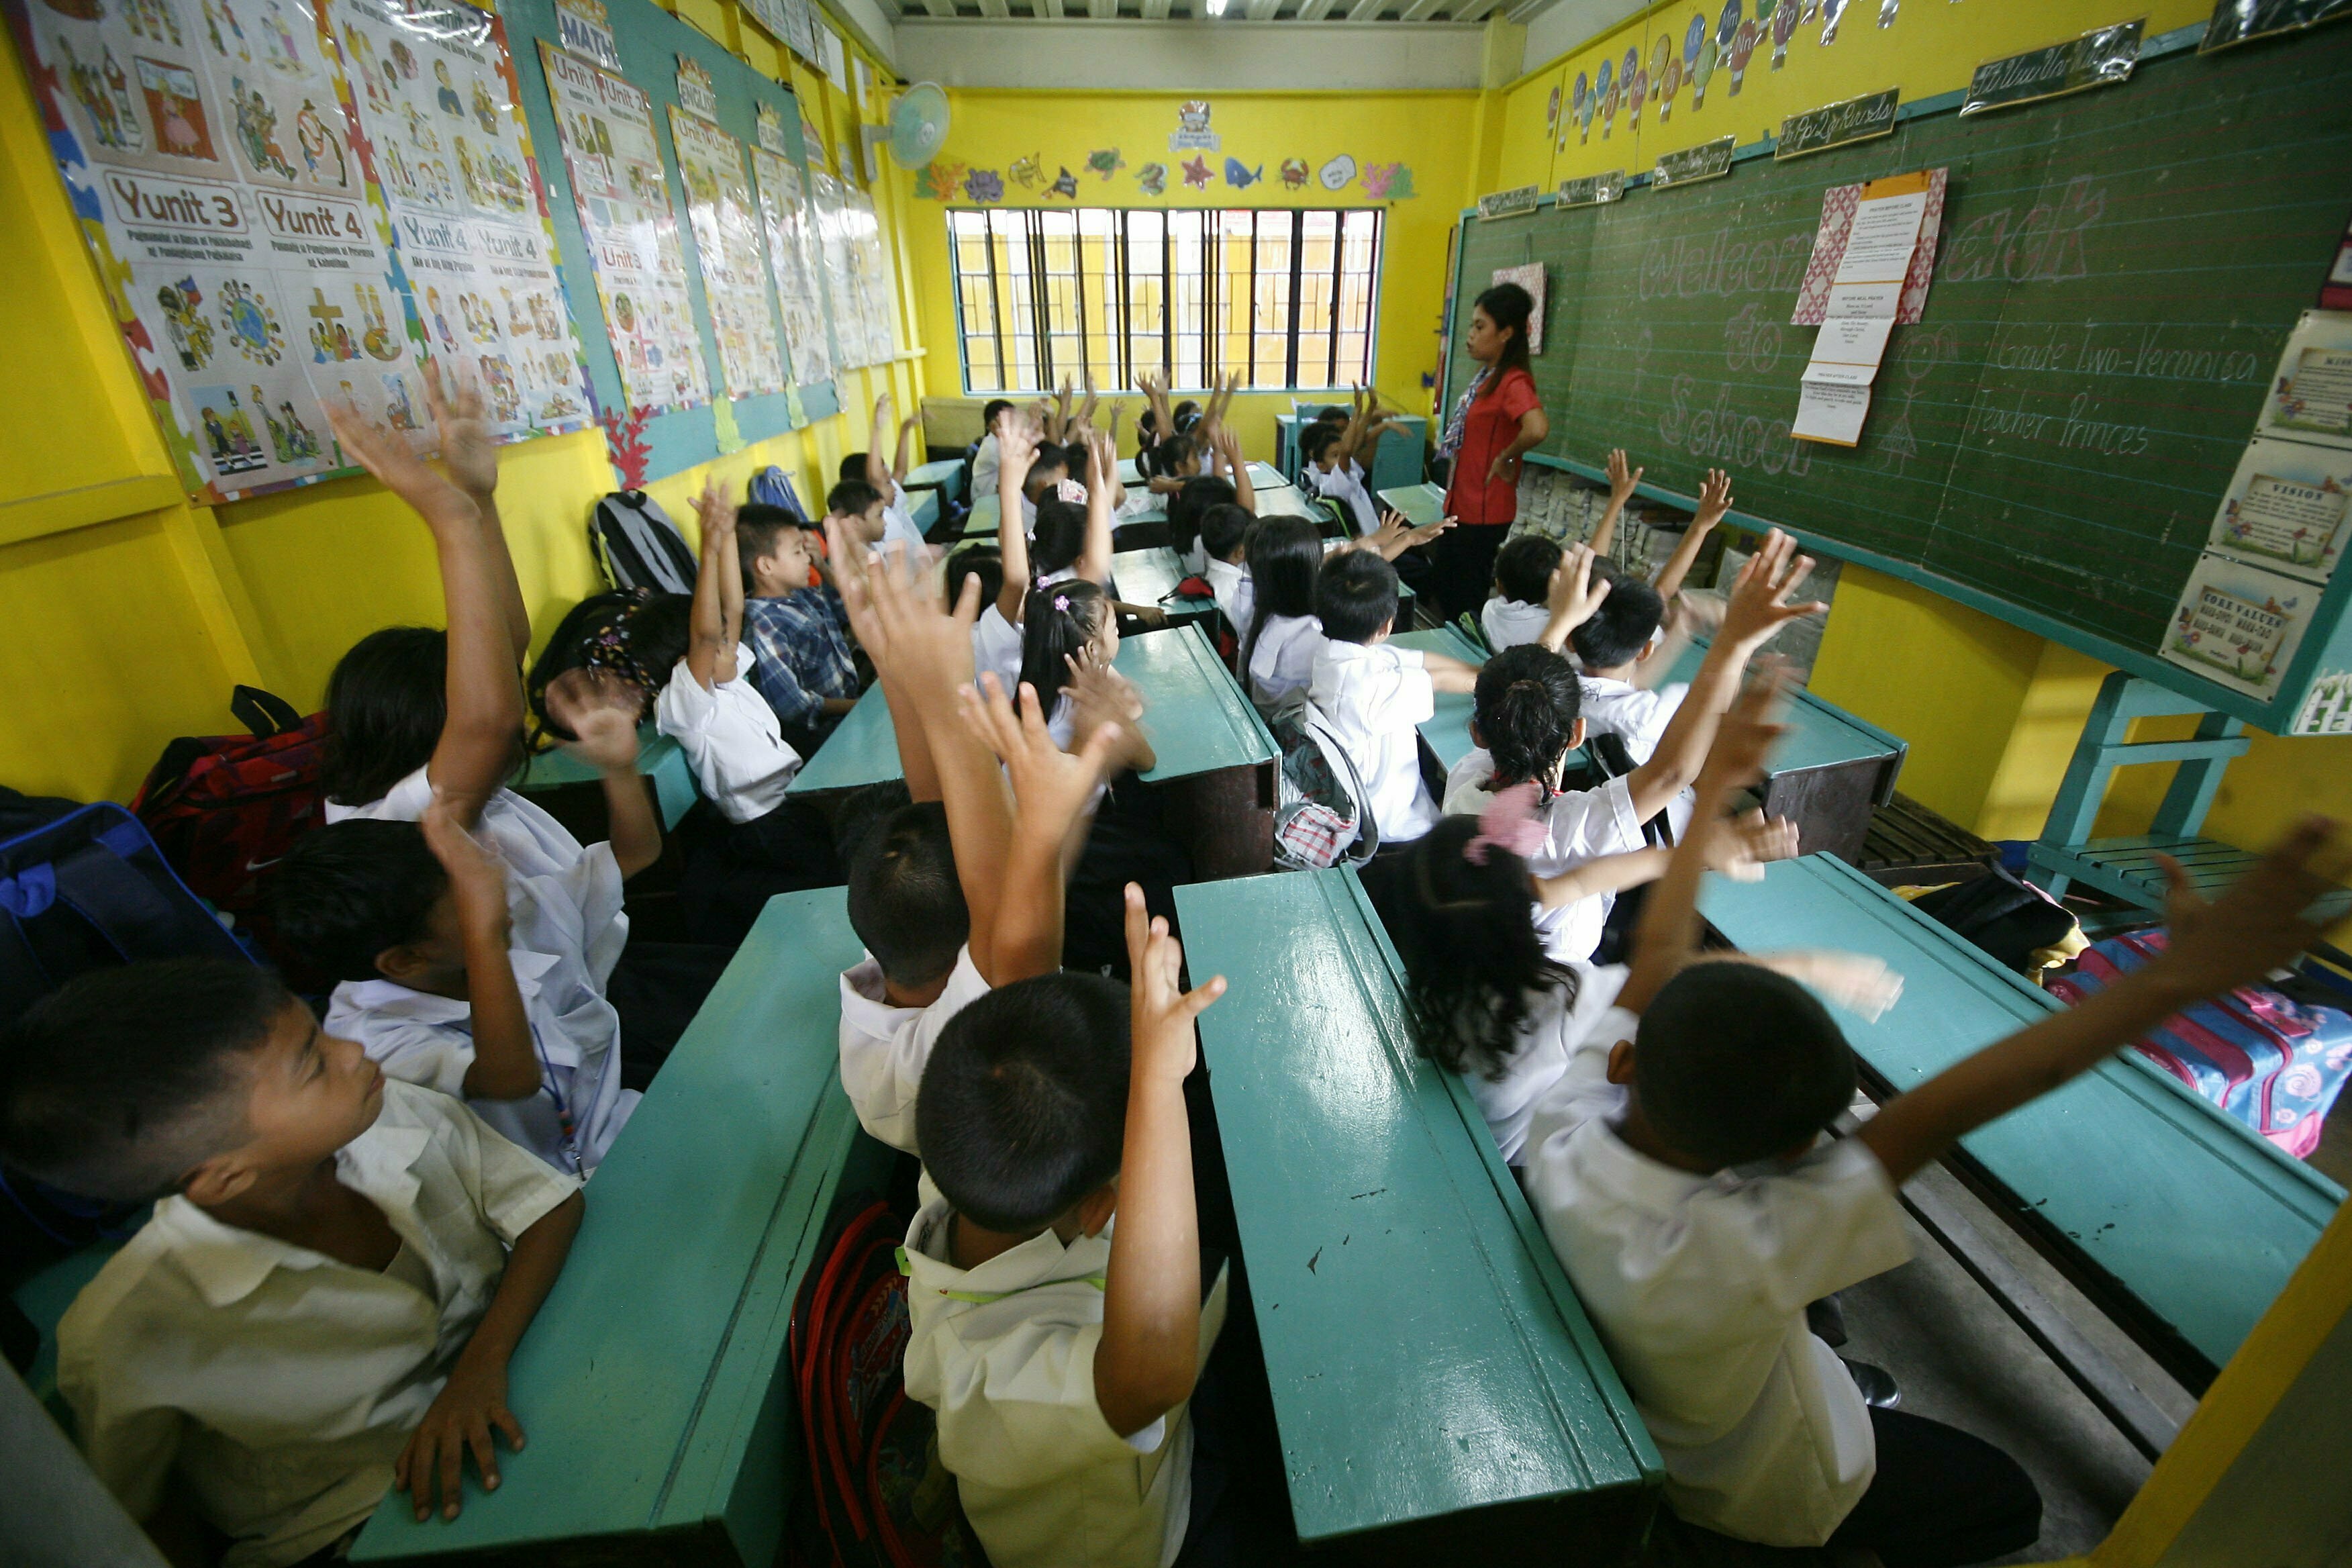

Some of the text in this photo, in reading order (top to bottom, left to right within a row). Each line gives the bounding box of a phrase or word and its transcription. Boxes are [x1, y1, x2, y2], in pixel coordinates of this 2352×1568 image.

[1778, 5, 1795, 34] Pp
[561, 15, 618, 66] MATH
[1735, 33, 1751, 54] Nn
[553, 54, 589, 89] Unit
[605, 79, 634, 109] Unit
[112, 177, 239, 227] Yunit 3
[263, 197, 363, 239] Yunit 4
[403, 215, 468, 251] Yunit 4
[478, 229, 538, 259] Yunit 4
[602, 246, 633, 268] Unit
[633, 253, 642, 269] 3
[1639, 226, 1814, 301] Welcom
[1725, 303, 1782, 373] to
[1998, 326, 2067, 370] Grade
[1973, 389, 2051, 440] Teacher
[2273, 483, 2323, 501] VISION
[2204, 593, 2234, 610] CORE
[2237, 605, 2283, 628] VALUES
